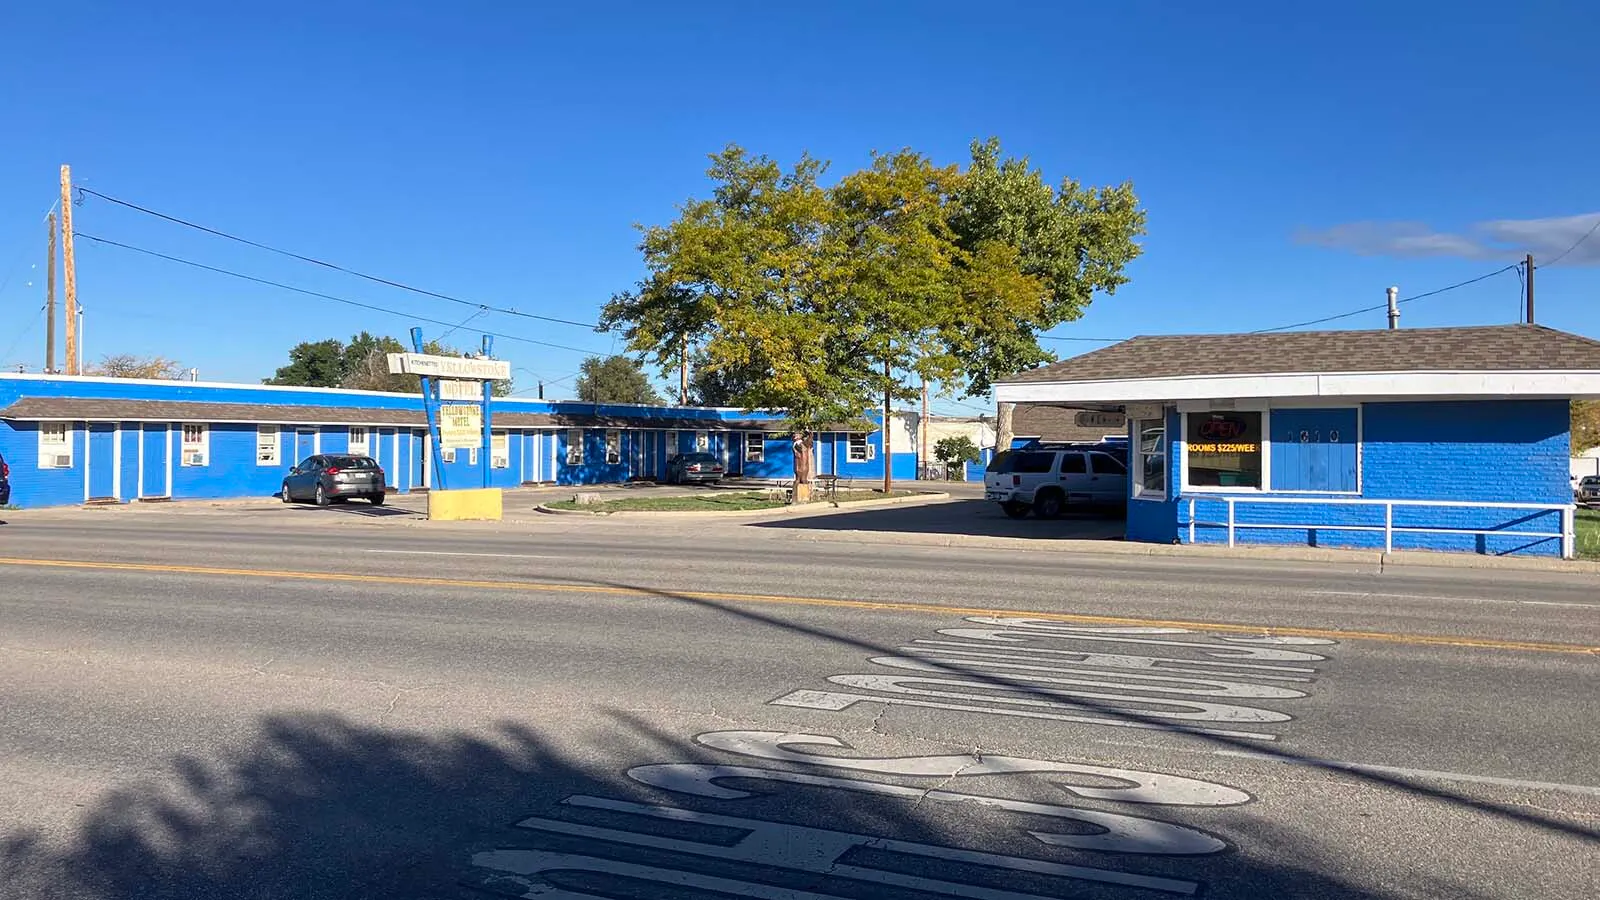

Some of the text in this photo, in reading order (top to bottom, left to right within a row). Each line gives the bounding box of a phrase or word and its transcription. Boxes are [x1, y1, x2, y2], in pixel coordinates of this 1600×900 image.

[440, 360, 507, 377] YELLOWSTONE
[444, 382, 477, 397] MOTEL
[442, 406, 479, 416] YELLOWSTONE
[452, 416, 470, 426] MOTEL
[1201, 421, 1240, 437] OPEN
[1287, 430, 1340, 443] 1610
[1187, 443, 1216, 452] ROOMS
